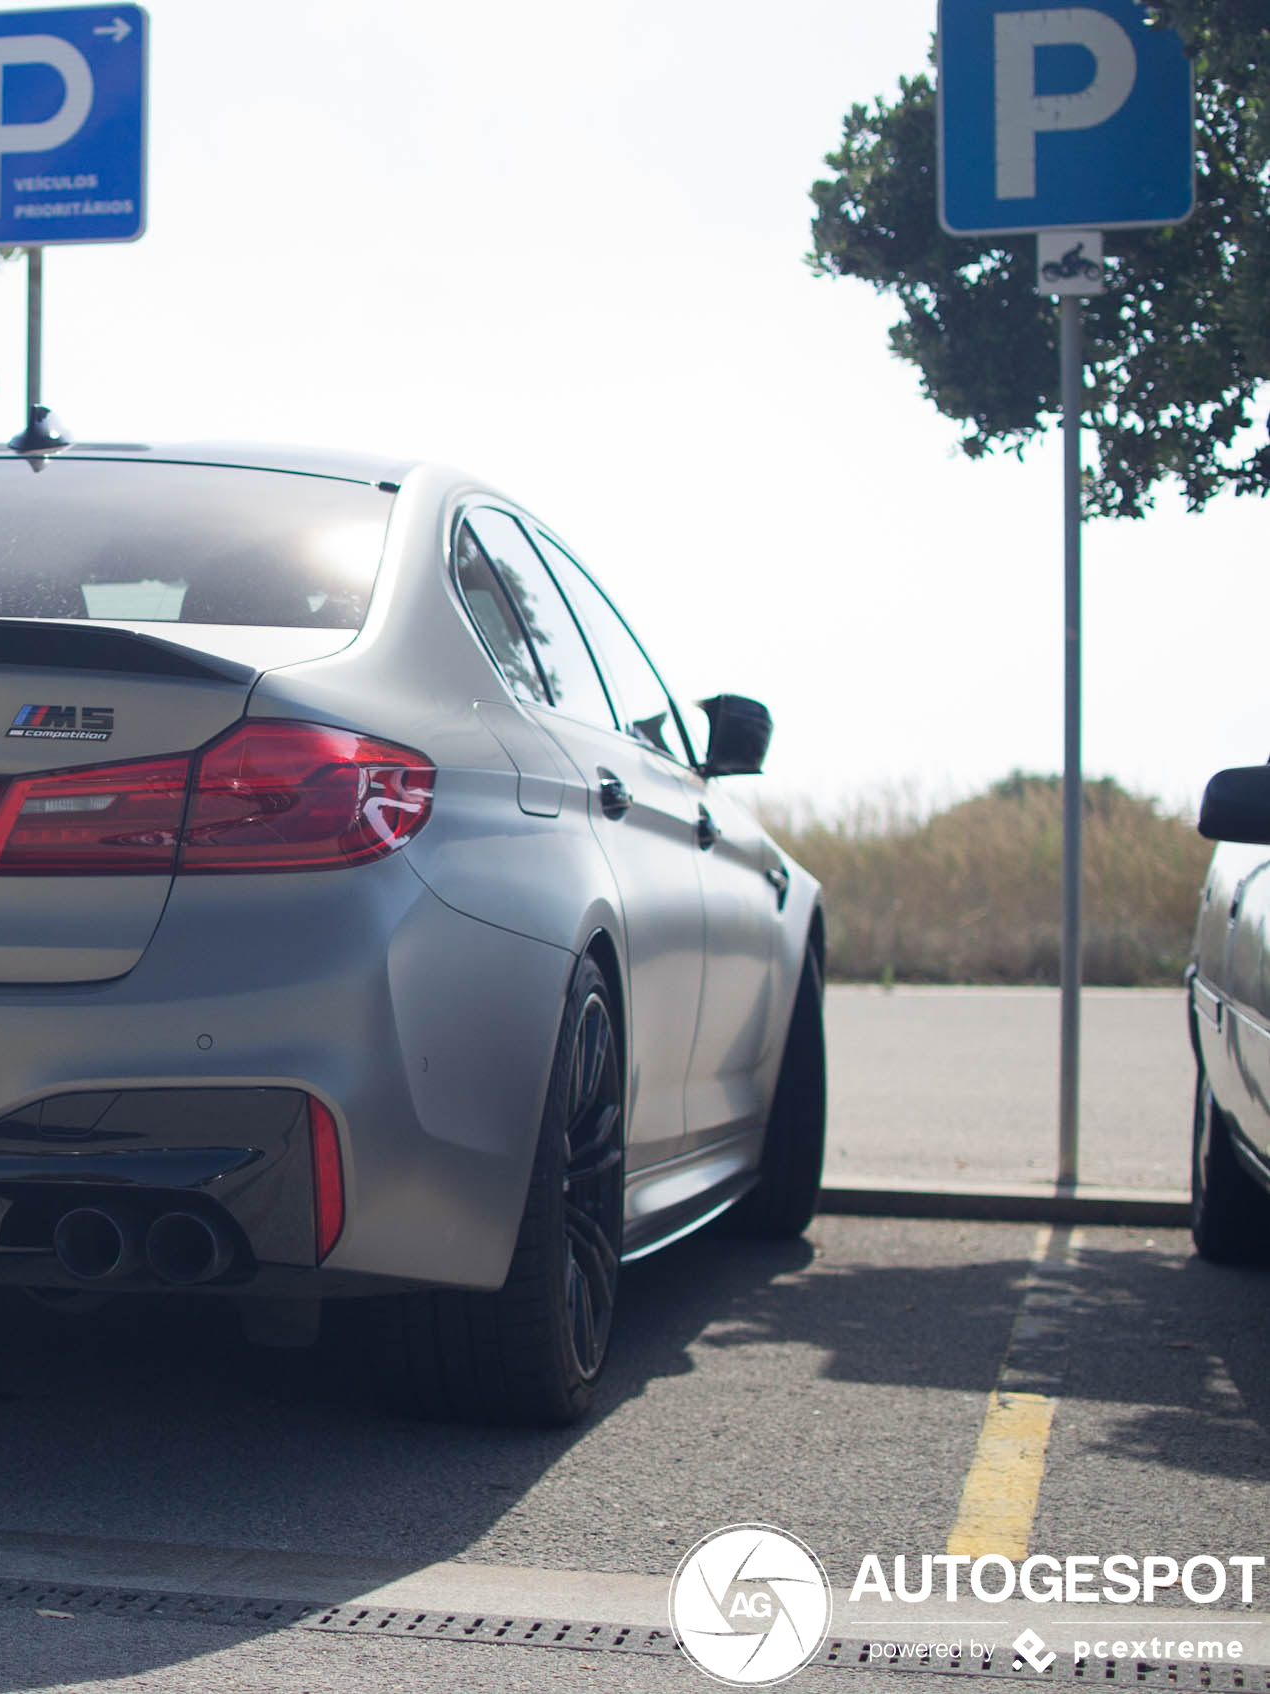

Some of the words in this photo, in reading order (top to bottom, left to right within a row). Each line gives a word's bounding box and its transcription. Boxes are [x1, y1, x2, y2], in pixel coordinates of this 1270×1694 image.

[994, 7, 1137, 199] P
[13, 174, 98, 192] VEÍCULOS
[13, 199, 134, 219] PRIORITÁRIOS
[39, 705, 115, 729] M5
[24, 729, 109, 740] competition
